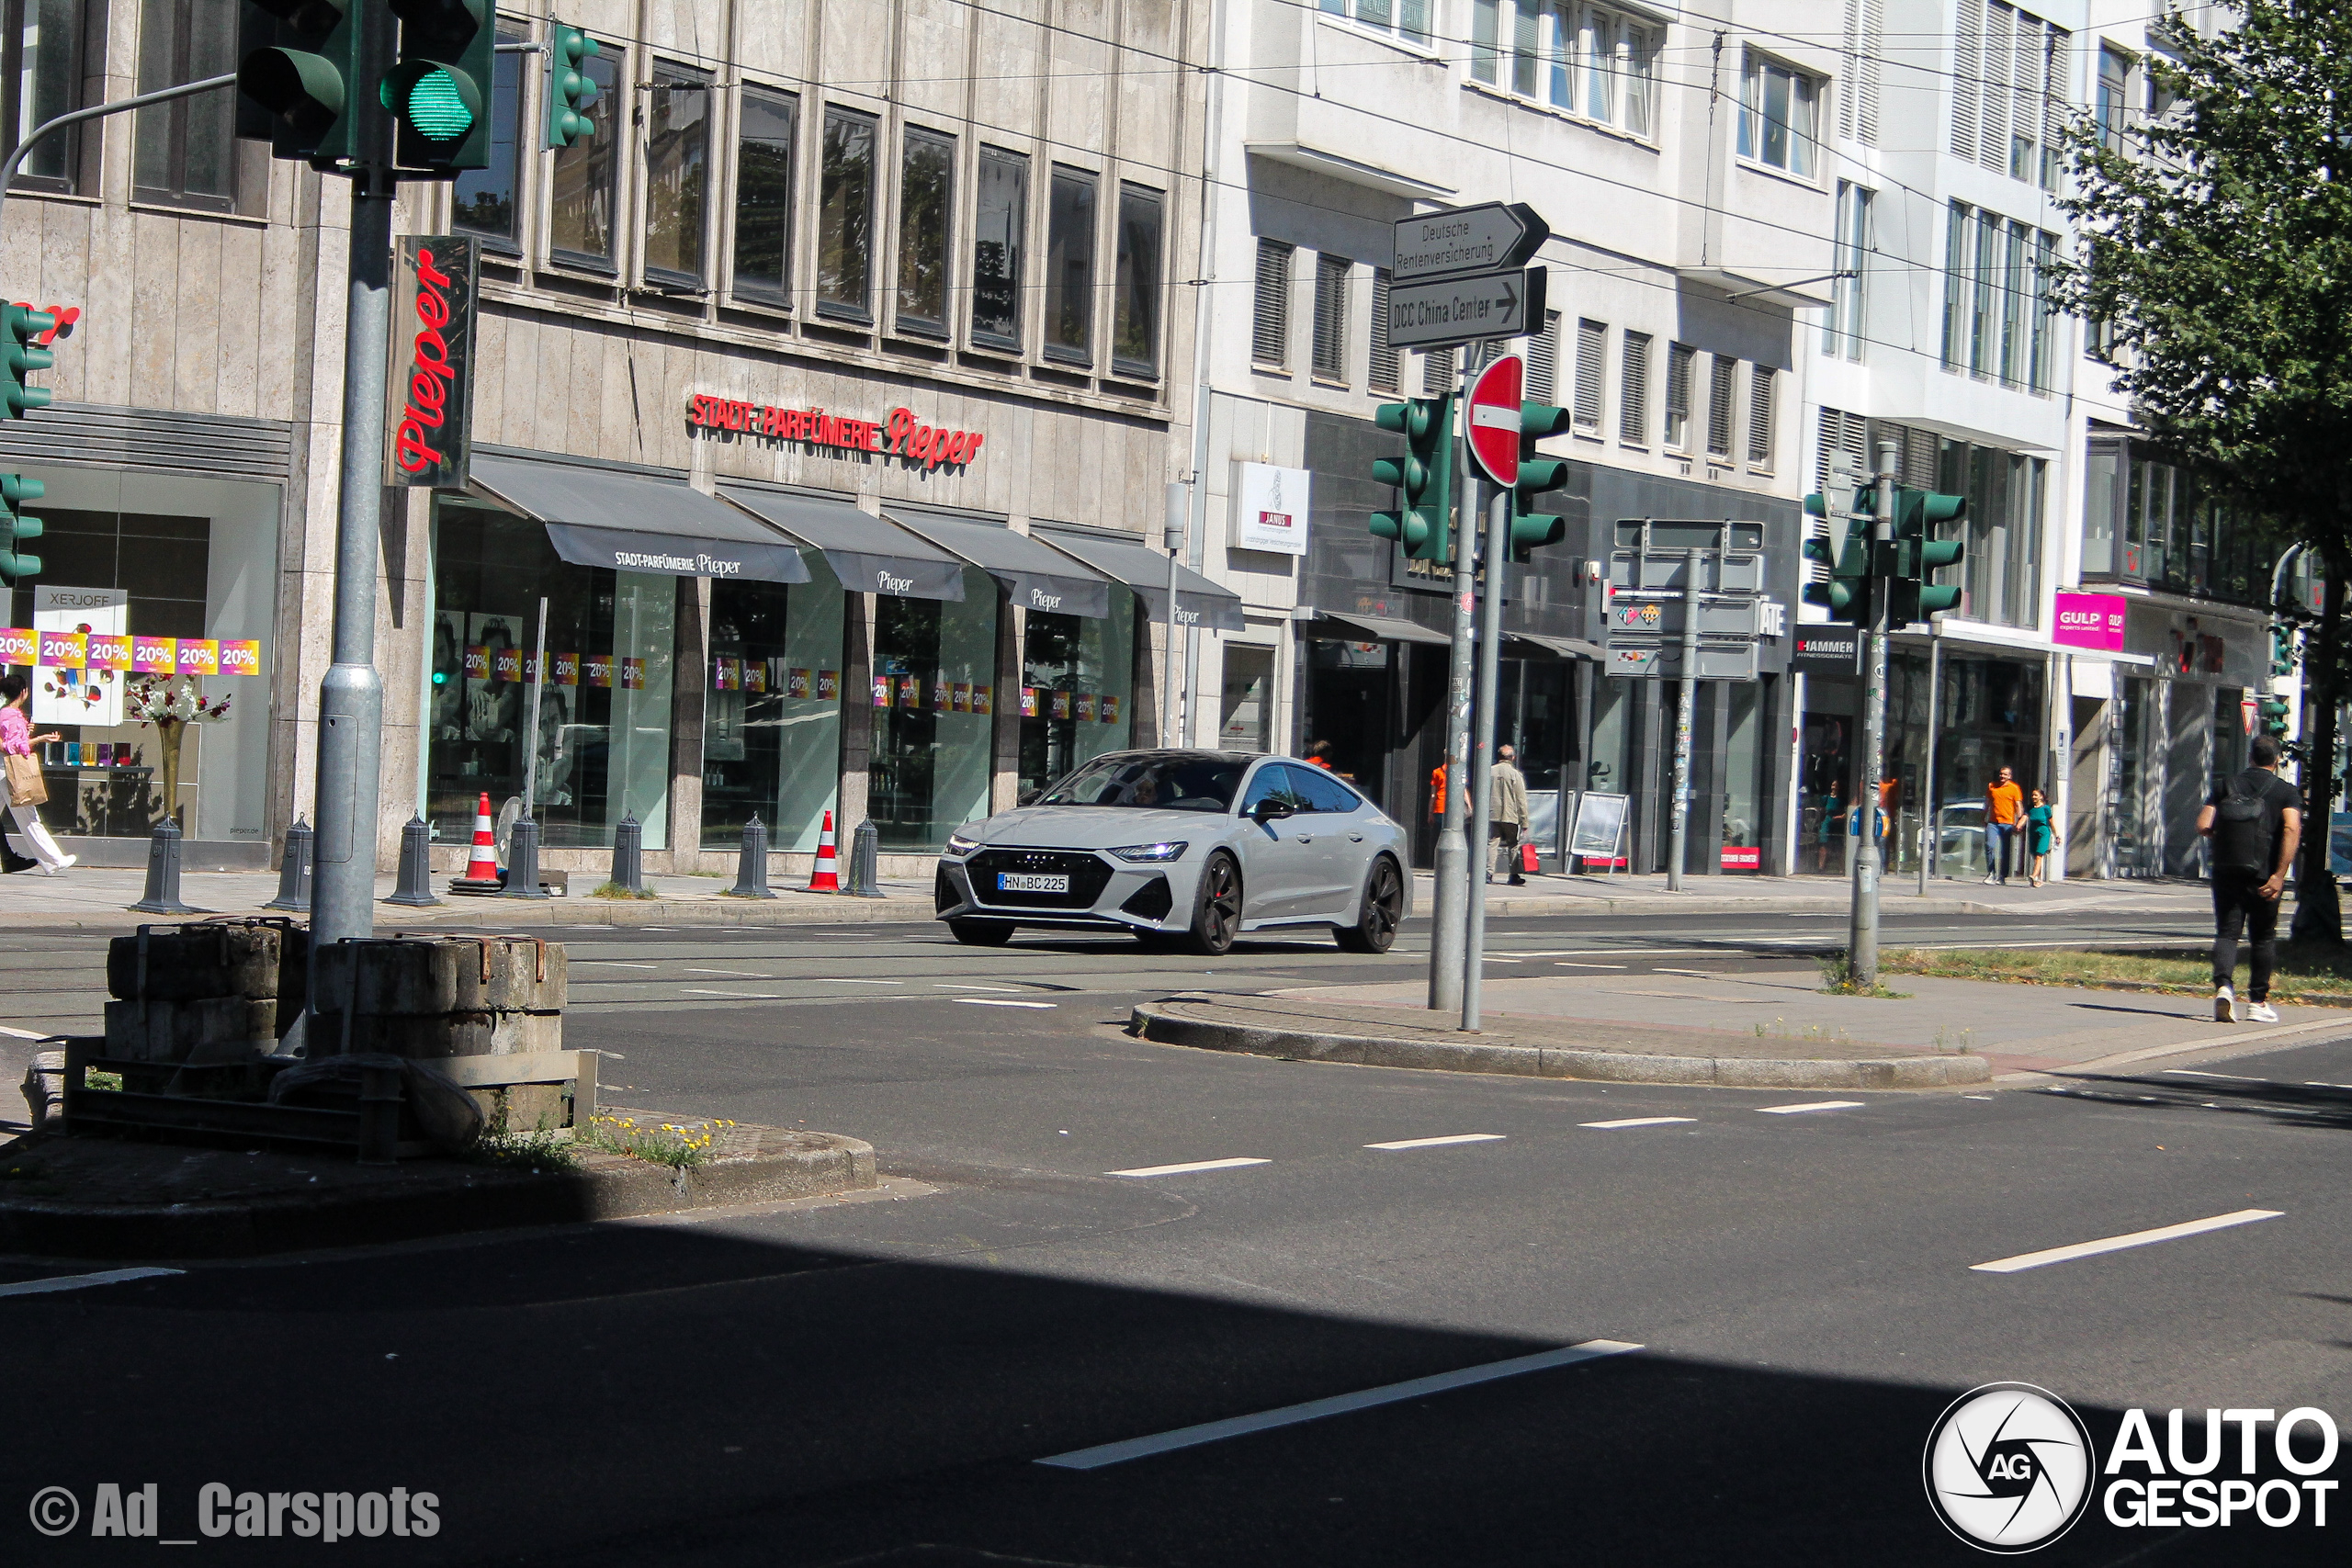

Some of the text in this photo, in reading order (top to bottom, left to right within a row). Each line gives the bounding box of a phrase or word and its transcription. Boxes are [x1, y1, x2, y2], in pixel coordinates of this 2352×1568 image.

[1422, 220, 1469, 243] Deutsche
[1396, 243, 1494, 271] Rentenversicherung
[1394, 295, 1490, 330] DCC China Center
[395, 248, 455, 473] Pieper
[888, 406, 984, 469] Pieper
[1265, 513, 1286, 526] JANUS
[695, 553, 741, 579] Pieper
[876, 570, 914, 596] Pieper
[50, 592, 110, 607] XERJOFF
[1030, 588, 1062, 612] Pieper
[1173, 604, 1200, 626] Pieper
[2059, 611, 2101, 625] GULP
[2108, 614, 2122, 626] GULP
[43, 640, 83, 659] 20%
[90, 643, 129, 660] 20%
[135, 645, 172, 663] 20%
[1797, 640, 1854, 653] HAMMER
[179, 649, 215, 665] 20%
[221, 649, 256, 665] 20%
[465, 653, 488, 670] 20%
[497, 657, 519, 672] 20%
[556, 660, 577, 676] 20%
[590, 663, 611, 678] 20%
[623, 665, 644, 681] 20%
[718, 666, 738, 681] 20%
[745, 669, 764, 683] 20%
[790, 675, 809, 691] 20%
[819, 678, 837, 692] 20%
[934, 689, 951, 703] 20%
[954, 691, 970, 705] 20%
[974, 694, 989, 706] 20%
[1102, 704, 1118, 716] 20%
[1004, 876, 1066, 890] HN BC 225
